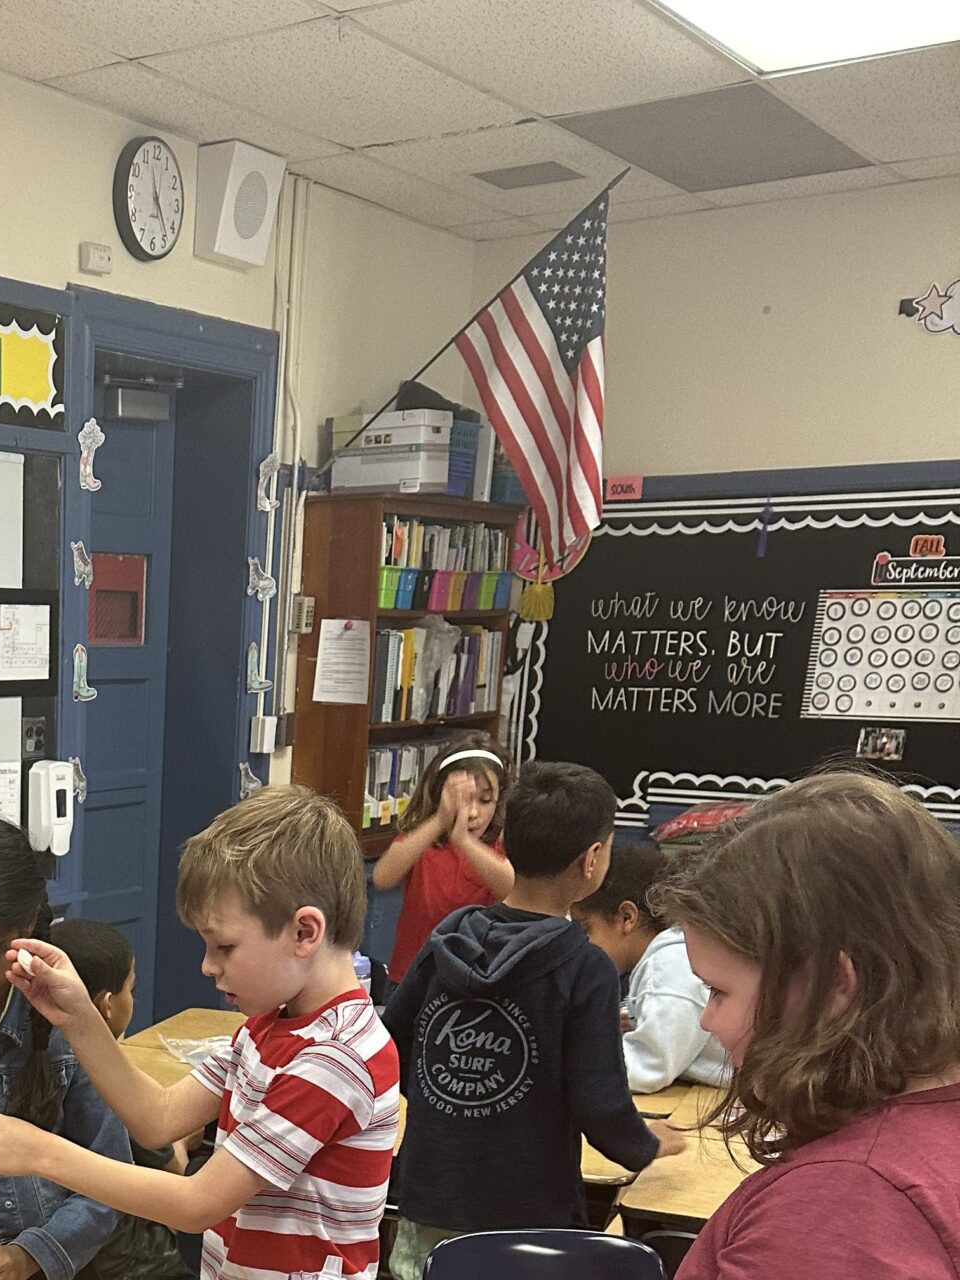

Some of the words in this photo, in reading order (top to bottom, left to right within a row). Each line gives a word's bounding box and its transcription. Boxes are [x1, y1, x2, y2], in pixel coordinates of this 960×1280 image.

[886, 561, 960, 585] September
[591, 592, 660, 622] what
[669, 598, 713, 623] we
[724, 596, 806, 623] know
[727, 631, 784, 659] BUT
[604, 655, 665, 682] who
[668, 657, 712, 684] we
[727, 657, 776, 686] are
[591, 687, 698, 714] MATTERS
[707, 690, 784, 719] MORE
[502, 998, 532, 1030] SINCE
[434, 1008, 513, 1055] Kona
[448, 1053, 496, 1073] SURF
[431, 1063, 506, 1097] COMPANY
[463, 1107, 492, 1118] NEW
[496, 1076, 535, 1114] JERSEY
